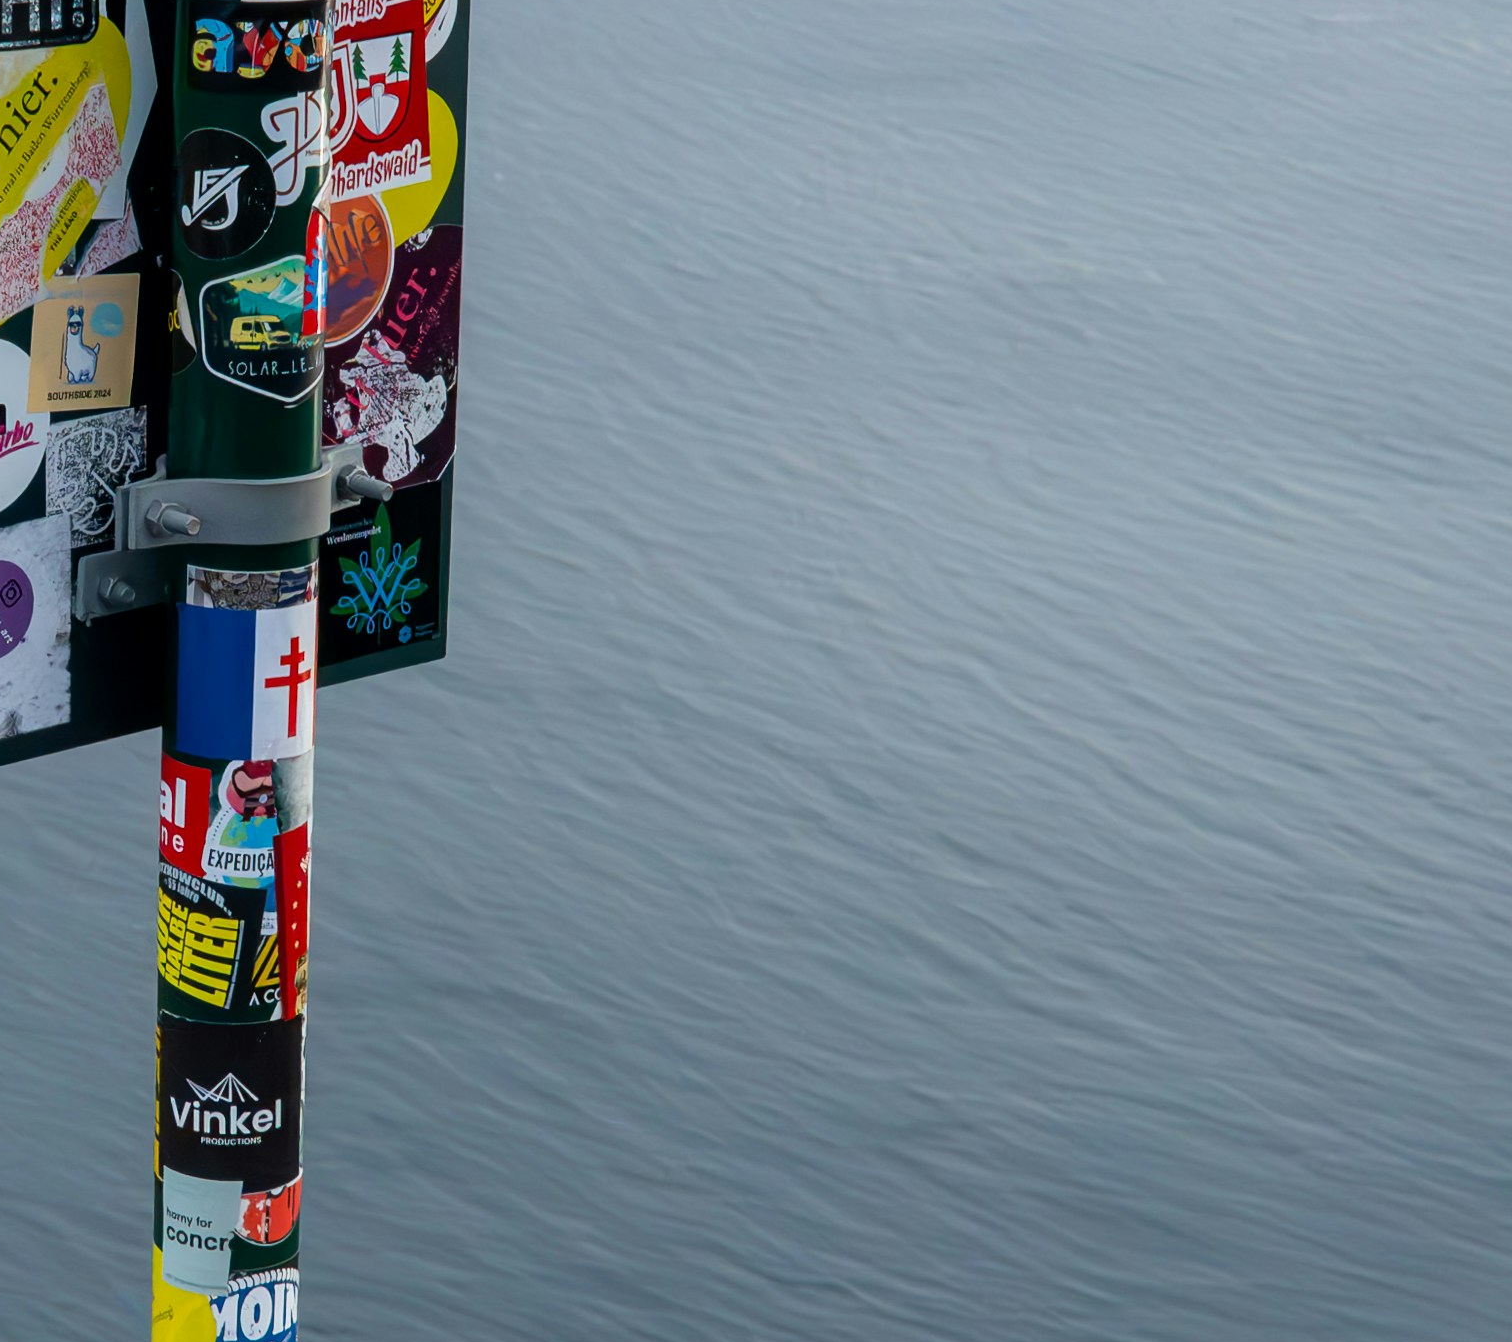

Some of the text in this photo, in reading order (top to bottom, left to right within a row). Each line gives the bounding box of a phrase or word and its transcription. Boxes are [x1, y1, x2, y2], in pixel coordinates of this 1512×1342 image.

[2, 171, 18, 196] mal
[15, 163, 26, 177] in
[47, 389, 112, 401] SOUTHSIDE 2024
[165, 900, 189, 987] HALBE
[178, 911, 239, 1008] LITER
[170, 1095, 282, 1135] Vinkel
[200, 1136, 262, 1146] PRODUCTIONS
[166, 1206, 213, 1228] horny for
[166, 1225, 232, 1252] concr
[211, 1283, 299, 1342] MOIN
